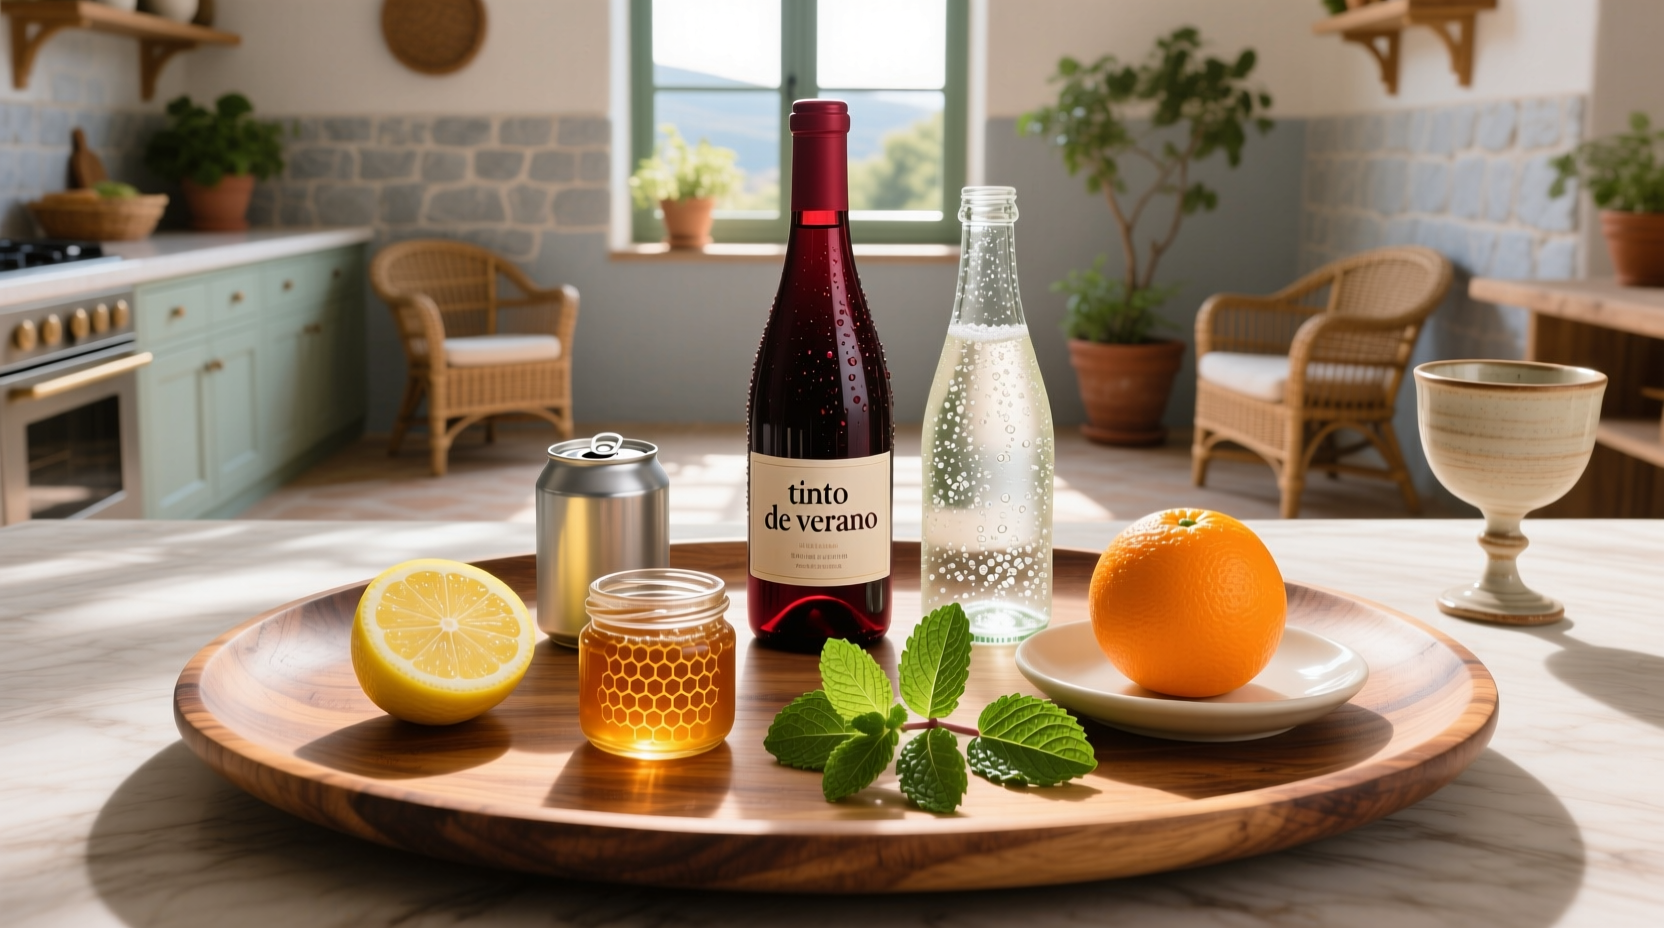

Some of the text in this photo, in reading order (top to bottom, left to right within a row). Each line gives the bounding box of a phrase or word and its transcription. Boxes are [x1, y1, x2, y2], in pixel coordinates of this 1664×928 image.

[788, 480, 848, 505] tinto
[765, 504, 878, 532] de verano
